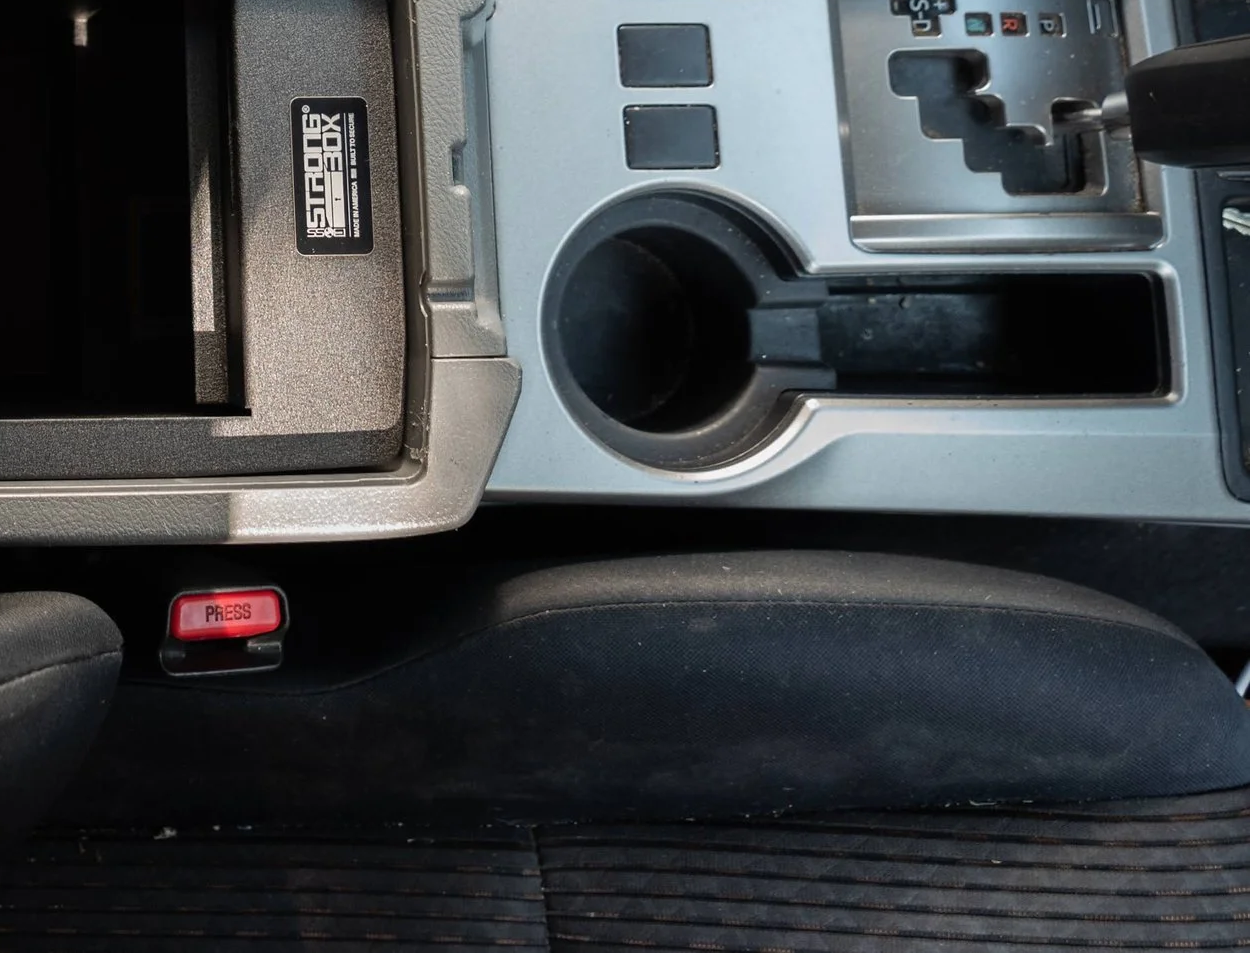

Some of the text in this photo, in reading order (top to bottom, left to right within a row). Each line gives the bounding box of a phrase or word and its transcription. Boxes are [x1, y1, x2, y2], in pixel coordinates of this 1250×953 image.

[966, 18, 986, 33] N
[1002, 18, 1019, 32] R
[1040, 19, 1055, 32] P
[349, 138, 355, 148] TO
[302, 113, 326, 229] STRONG
[351, 181, 359, 210] AMERICA
[205, 603, 252, 622] PRESS
